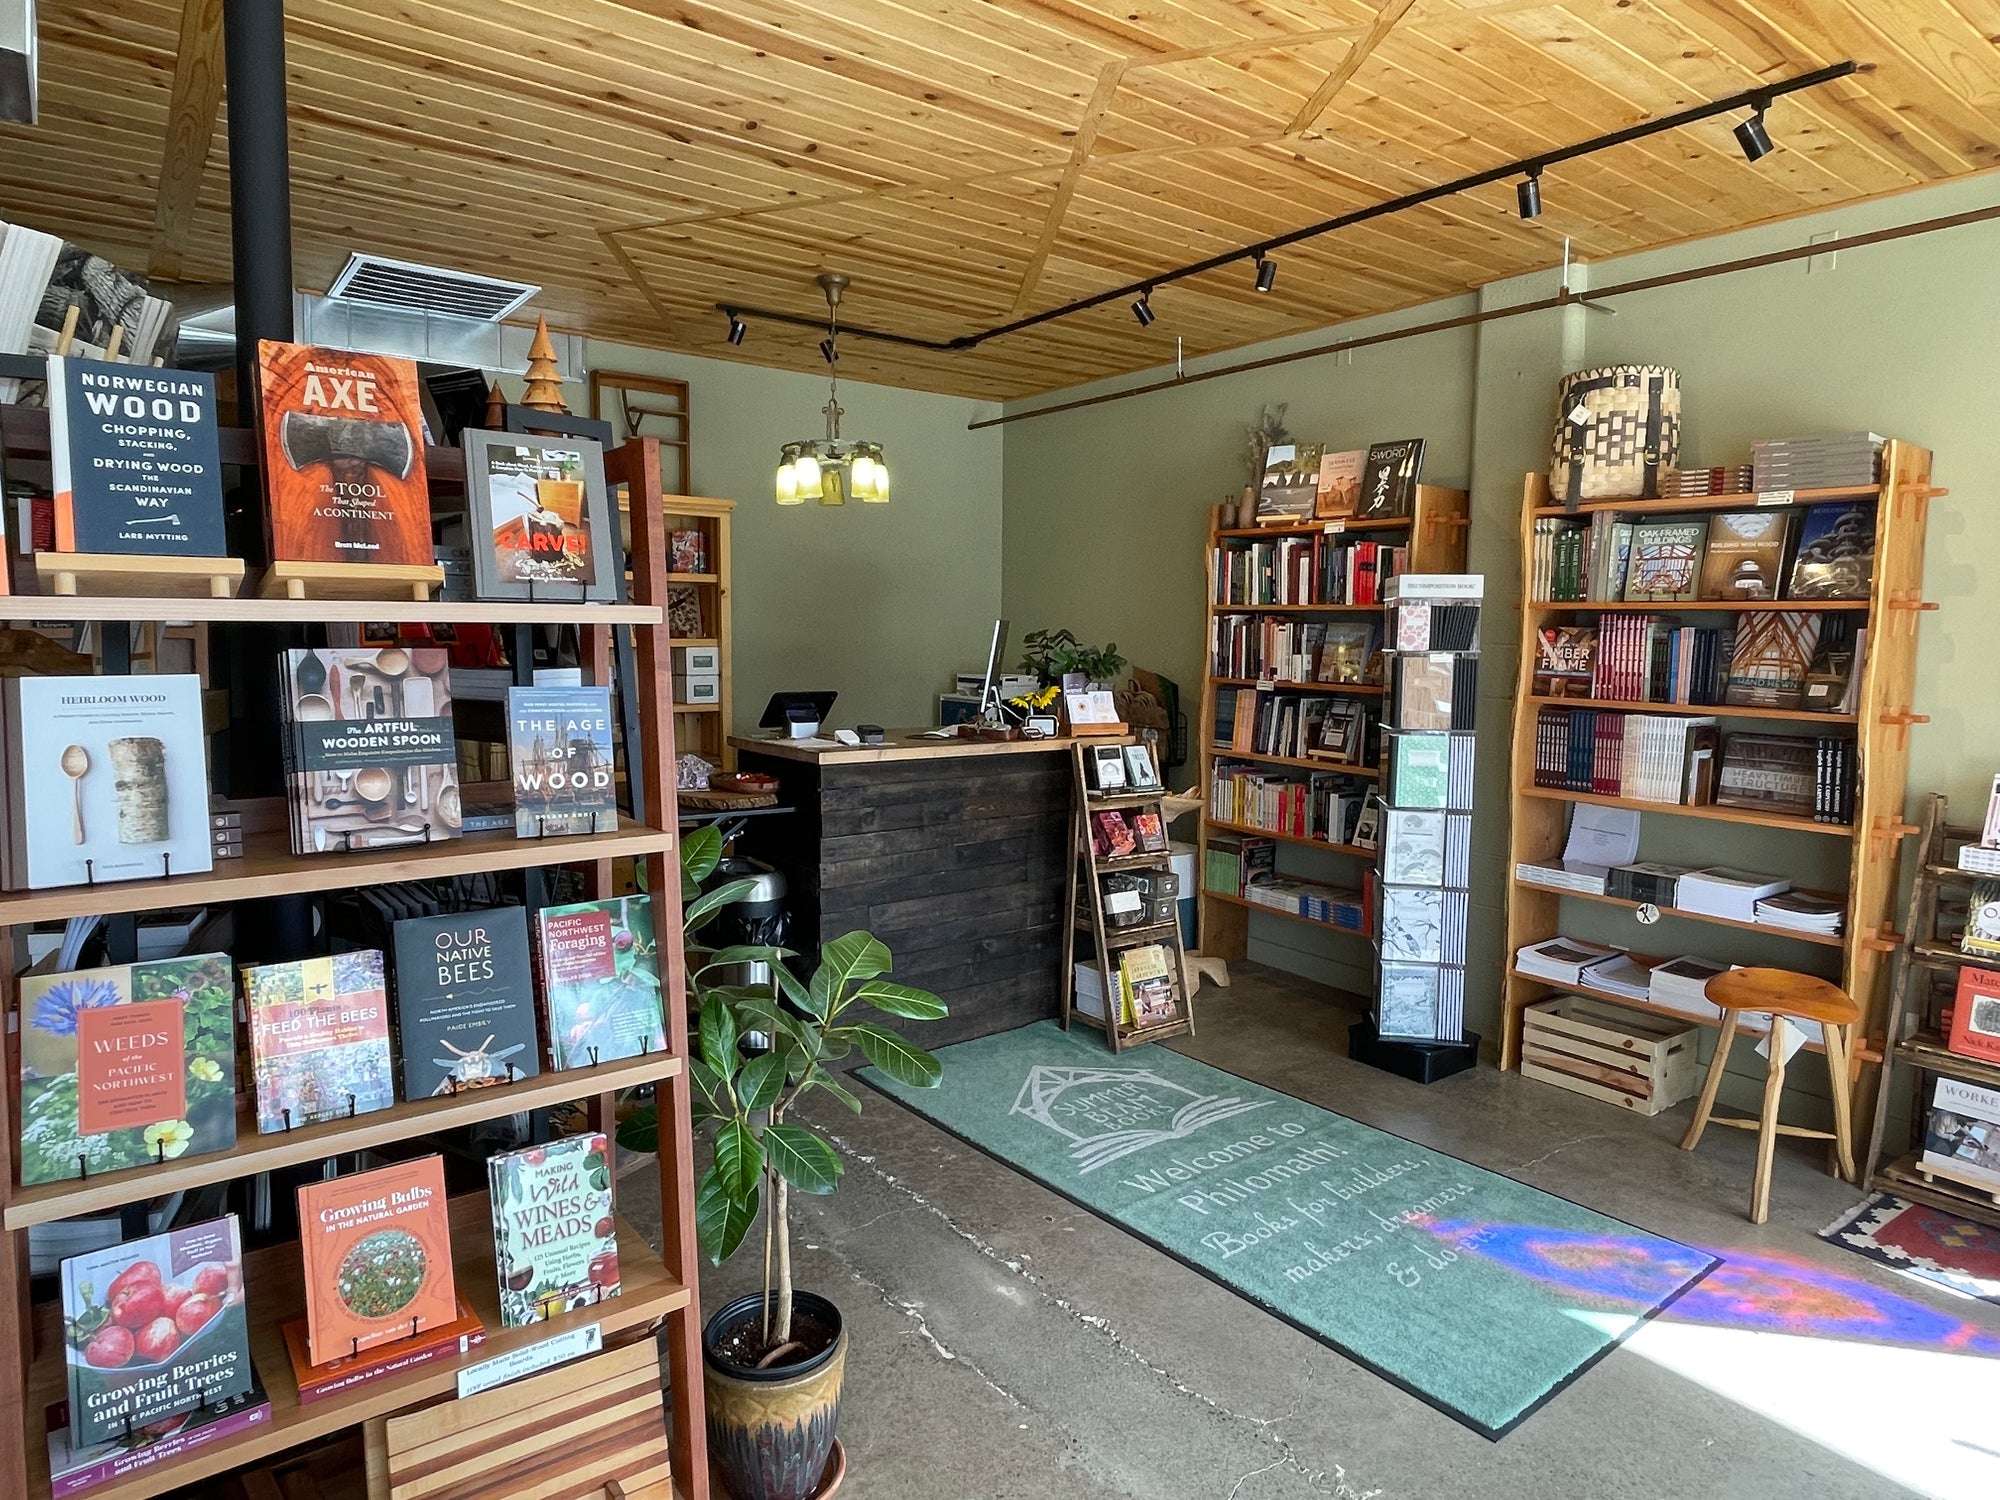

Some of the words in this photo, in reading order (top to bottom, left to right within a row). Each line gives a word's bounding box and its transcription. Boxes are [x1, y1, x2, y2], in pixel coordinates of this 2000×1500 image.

[303, 361, 375, 380] American
[81, 372, 204, 397] NORWEGIAN
[303, 374, 379, 413] AXE
[84, 391, 201, 423] WOOD
[102, 423, 192, 440] CHOPPING,
[117, 439, 178, 452] STACKING,
[1370, 448, 1406, 461] SWORD
[93, 457, 152, 471] DRYING
[156, 462, 204, 474] WOOD
[141, 474, 159, 482] THE
[108, 483, 192, 495] SCANDINAVIAN
[320, 484, 334, 493] The
[335, 482, 386, 498] TOOL
[134, 496, 169, 508] WAY
[349, 498, 376, 508] Shaped
[313, 507, 321, 516] A
[323, 507, 395, 521] CONTINENT
[119, 532, 143, 540] LARS
[145, 533, 189, 542] MYTTING
[353, 541, 380, 550] McLeod
[498, 531, 587, 556] CARVE!
[1643, 535, 1692, 545] BUILDINGS
[1541, 658, 1586, 671] FME
[1737, 677, 1765, 687] HAND
[1766, 679, 1798, 688] HEWN
[60, 694, 128, 706] HEIRLOOM
[129, 693, 167, 703] WOOD
[364, 721, 418, 734] ARTFUL
[516, 719, 556, 732] THE
[566, 718, 606, 731] AGE
[321, 736, 389, 750] WOODEN
[392, 733, 441, 747] SPOON
[551, 747, 577, 759] OF
[518, 770, 610, 791] WOOD
[1732, 769, 1770, 780] HEAVY
[1773, 773, 1815, 785] TIMBER
[1732, 777, 1814, 793] STRUCTURES
[548, 918, 582, 930] PACIFIC
[548, 923, 605, 938] NORTHWEST
[434, 928, 491, 950] OUR
[549, 934, 606, 952] Foraging
[436, 945, 492, 964] NATIVE
[438, 960, 495, 986] BEES
[261, 1018, 302, 1036] FEED
[305, 1013, 337, 1029] THE
[340, 1007, 378, 1024] BEES
[93, 1031, 169, 1054] WEEDS
[108, 1062, 157, 1077] PACIFIC
[93, 1071, 175, 1091] NORTHWEST
[1053, 1081, 1149, 1117] SUMMER
[1083, 1094, 1160, 1123] BEAM
[1104, 1104, 1175, 1131] BOOKS
[1122, 1133, 1275, 1196] Welcome
[1264, 1121, 1306, 1139] to
[534, 1161, 574, 1178] MAKING
[1176, 1141, 1350, 1216] Philomath!
[529, 1173, 580, 1203] Wild
[320, 1196, 388, 1224] Growing
[391, 1185, 433, 1205] Bulbs
[513, 1195, 581, 1230] WINES
[583, 1191, 601, 1211] &
[1199, 1211, 1298, 1261] Books
[1286, 1193, 1338, 1229] for
[1319, 1158, 1429, 1202] builders,
[325, 1223, 336, 1234] IN
[337, 1217, 356, 1231] THE
[356, 1208, 395, 1227] NATURAL
[396, 1199, 430, 1217] GARDEN
[520, 1214, 593, 1251] MEADS
[1280, 1229, 1383, 1285] makers,
[1366, 1182, 1474, 1234] dreamers
[544, 1247, 569, 1258] Unusual
[569, 1241, 591, 1252] Recipes
[544, 1257, 562, 1267] Using
[562, 1259, 585, 1270] Flowers
[560, 1269, 577, 1278] More
[1385, 1261, 1421, 1289] &
[466, 1363, 491, 1377] Locally
[492, 1355, 511, 1367] Made
[550, 1333, 575, 1346] Cutting
[373, 1367, 385, 1377] the
[386, 1360, 409, 1371] Natural
[86, 1371, 169, 1408] Growing
[173, 1349, 238, 1378] Berries
[92, 1399, 132, 1424] and
[135, 1382, 182, 1411] Fruit
[184, 1365, 235, 1391] Trees
[107, 1419, 118, 1430] IN
[119, 1412, 137, 1426] TE
[138, 1401, 173, 1421] PACIFIC
[113, 1448, 152, 1467] Growing
[153, 1436, 186, 1454] Berries
[114, 1464, 133, 1476] and
[133, 1456, 156, 1469] Fruit
[158, 1445, 183, 1459] Trees
